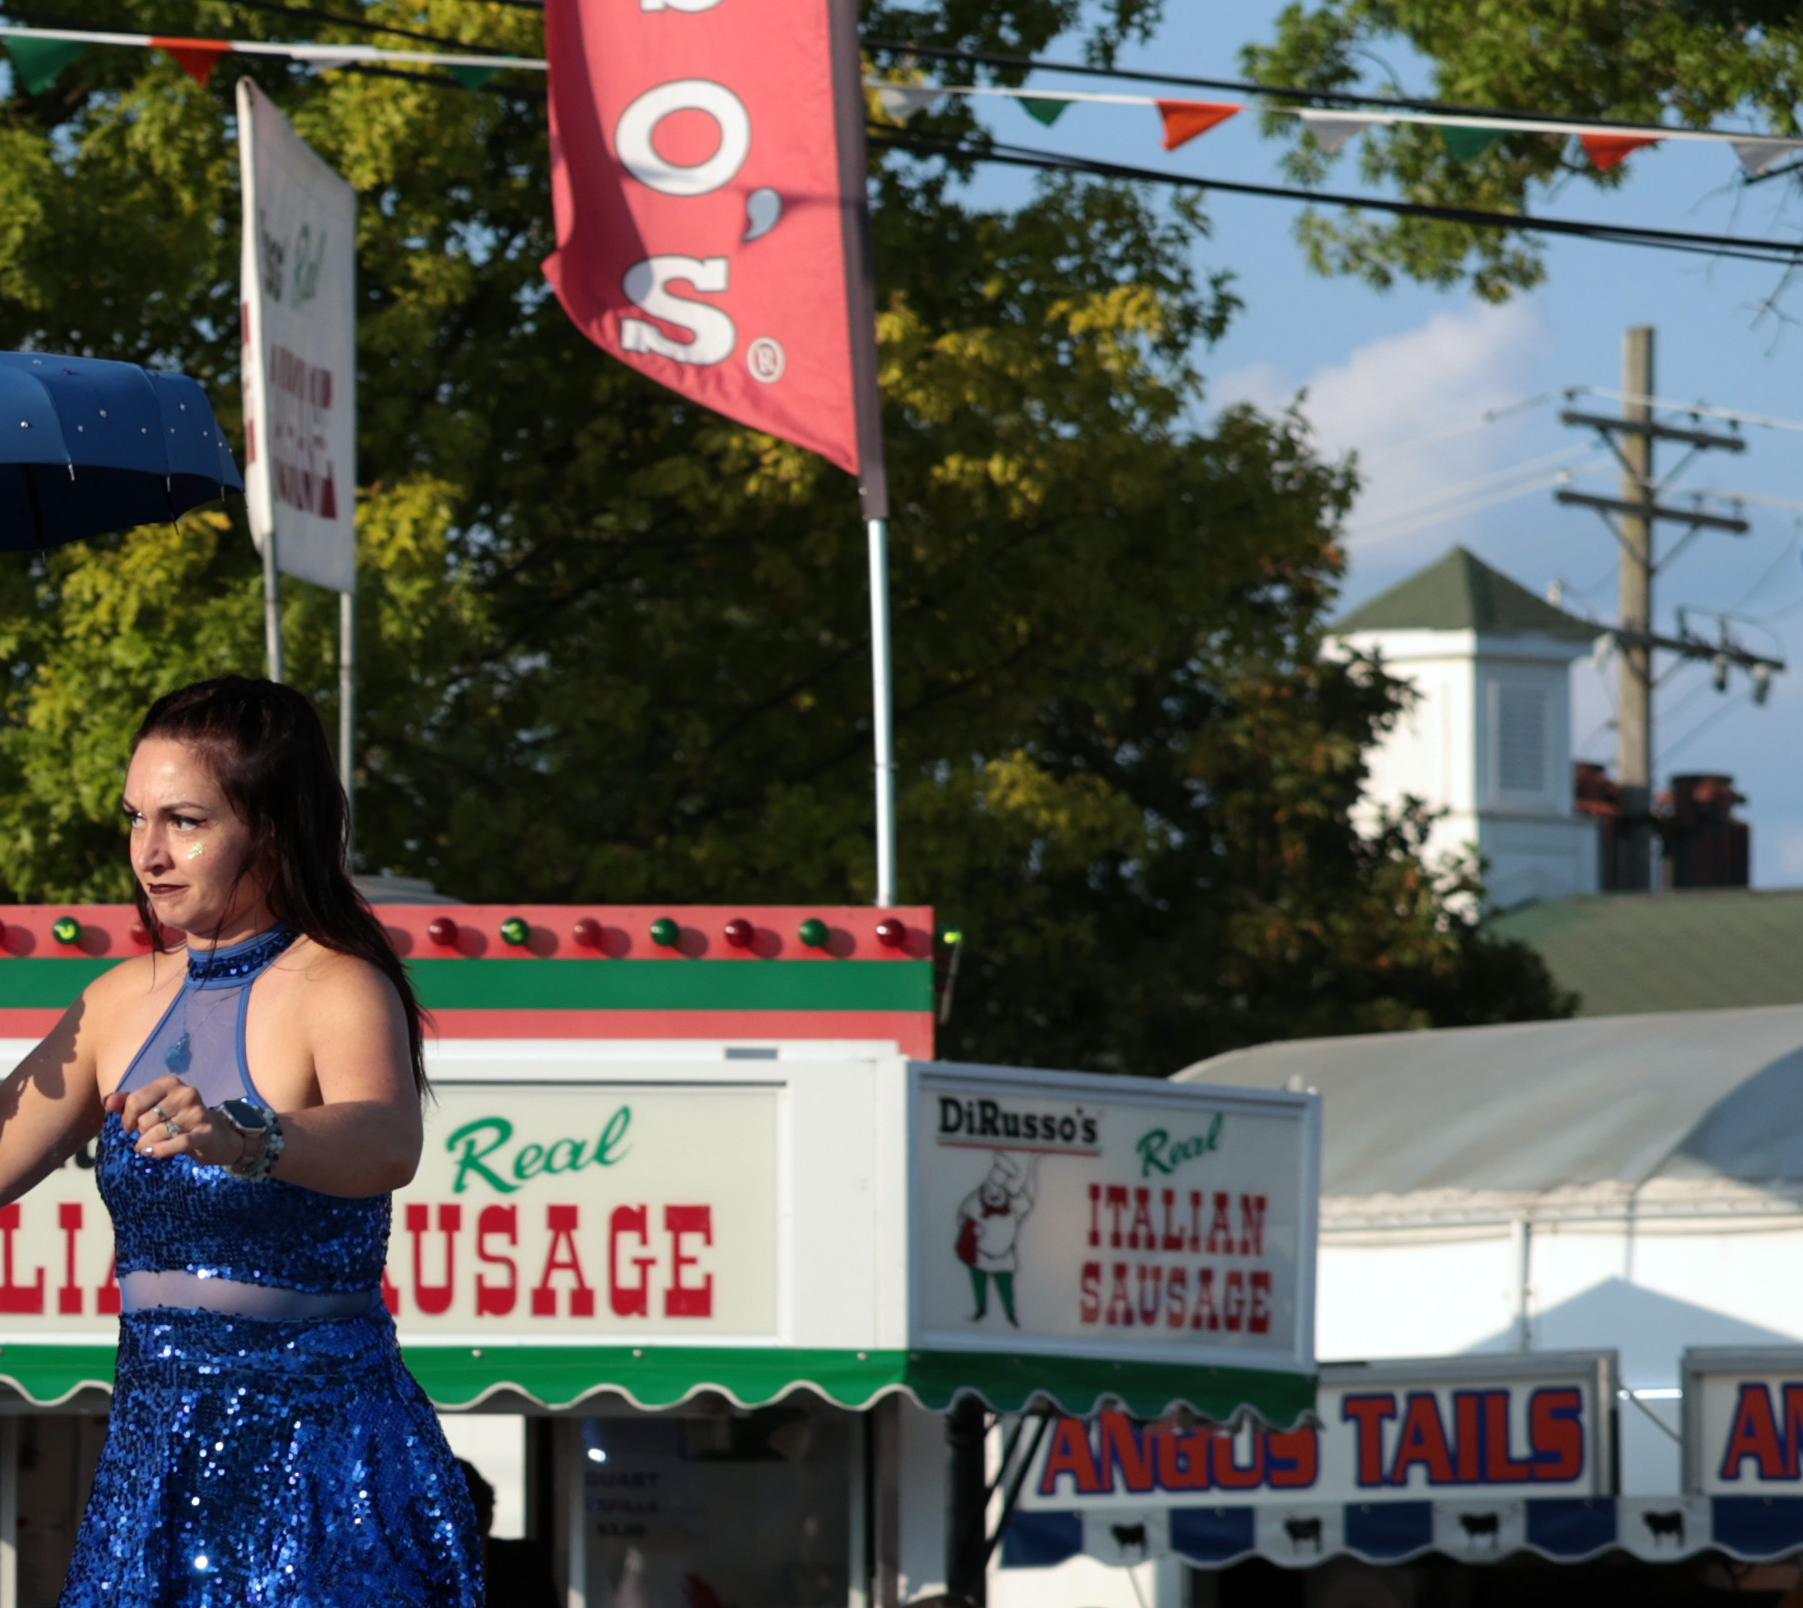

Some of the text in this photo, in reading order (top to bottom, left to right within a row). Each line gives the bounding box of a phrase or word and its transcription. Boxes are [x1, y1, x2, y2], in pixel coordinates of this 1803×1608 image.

[445, 1105, 633, 1195] Real
[937, 1096, 1224, 1178] DiRusso's Real
[1088, 1184, 1268, 1256] ITALIAN
[1080, 1261, 1273, 1334] SAUSAGE
[1039, 1384, 1585, 1496] ANGUS TAILS
